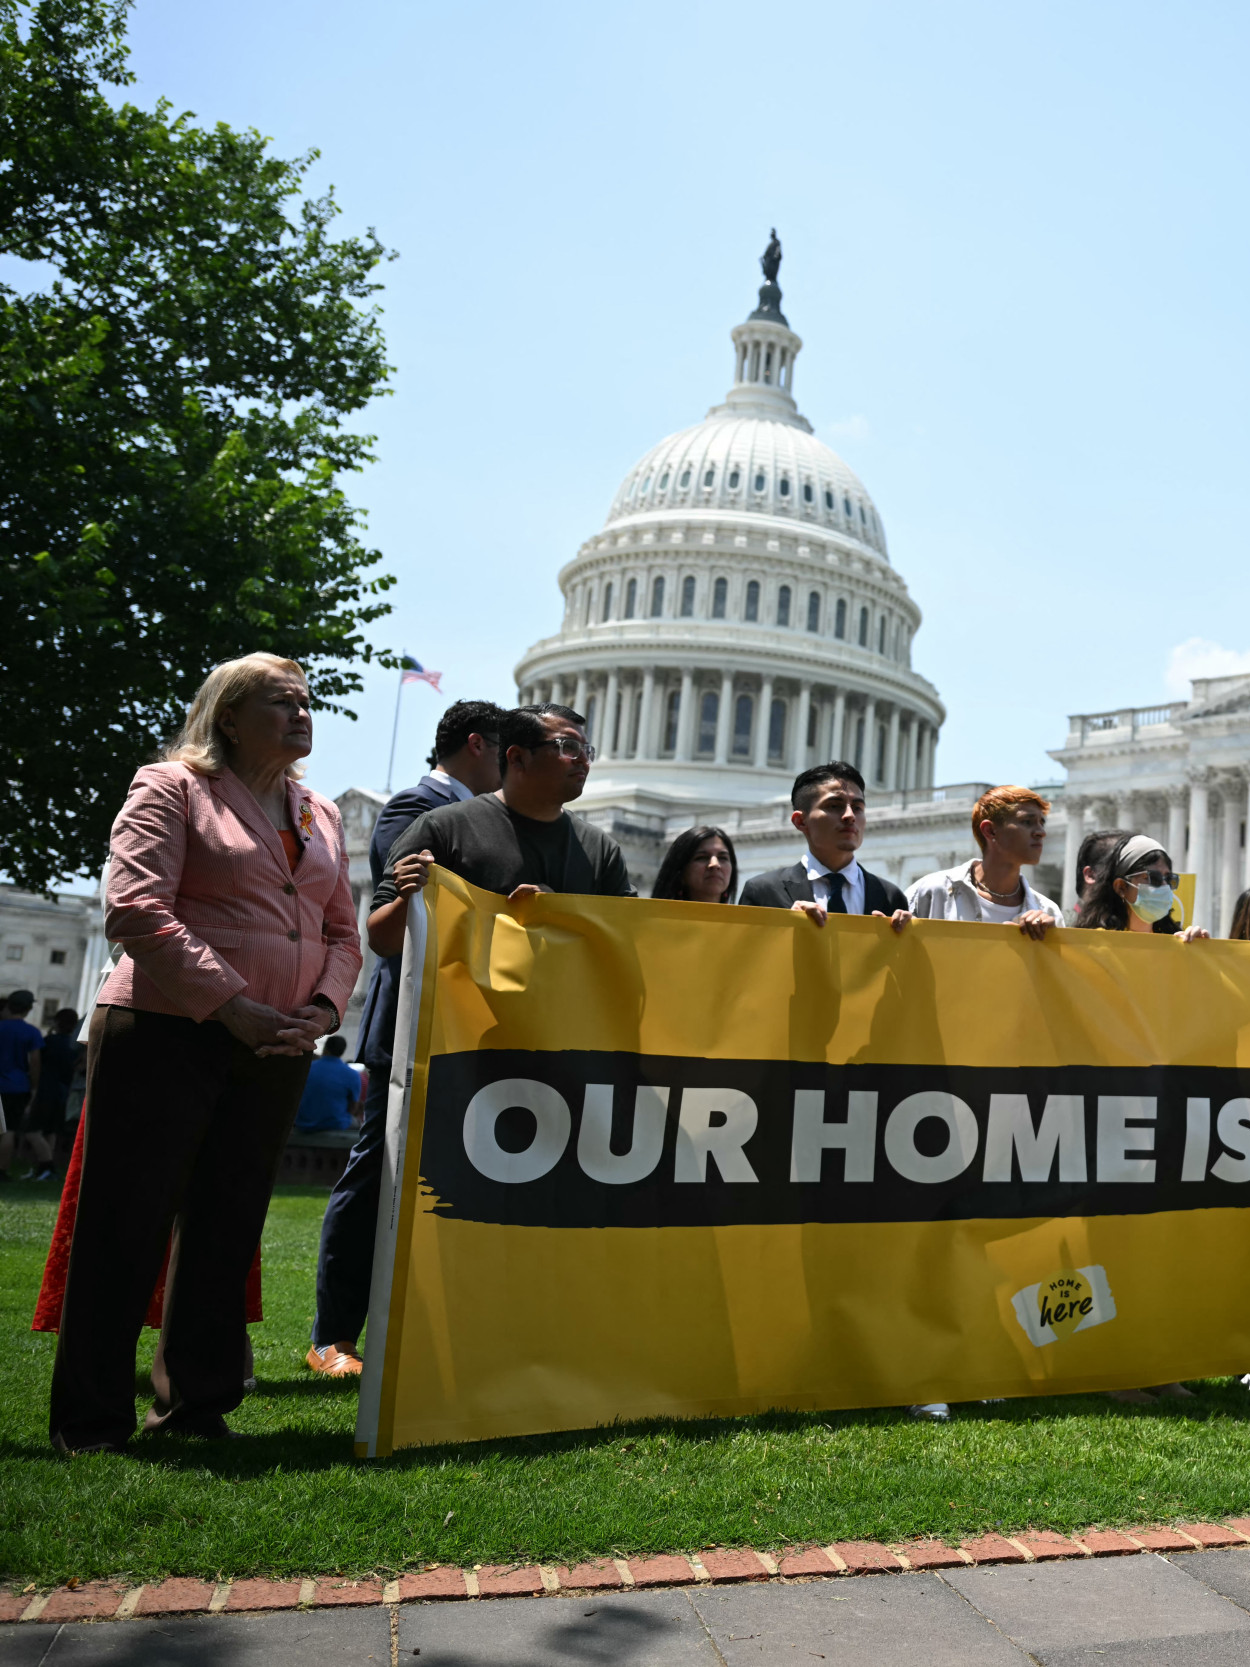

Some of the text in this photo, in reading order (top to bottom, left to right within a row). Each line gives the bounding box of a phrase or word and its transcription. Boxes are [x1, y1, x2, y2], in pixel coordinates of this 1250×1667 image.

[463, 1078, 760, 1184] OUR
[789, 1089, 1158, 1184] HOME
[1049, 1279, 1082, 1291] HOME
[1060, 1290, 1070, 1298] IS
[1040, 1296, 1094, 1327] here
